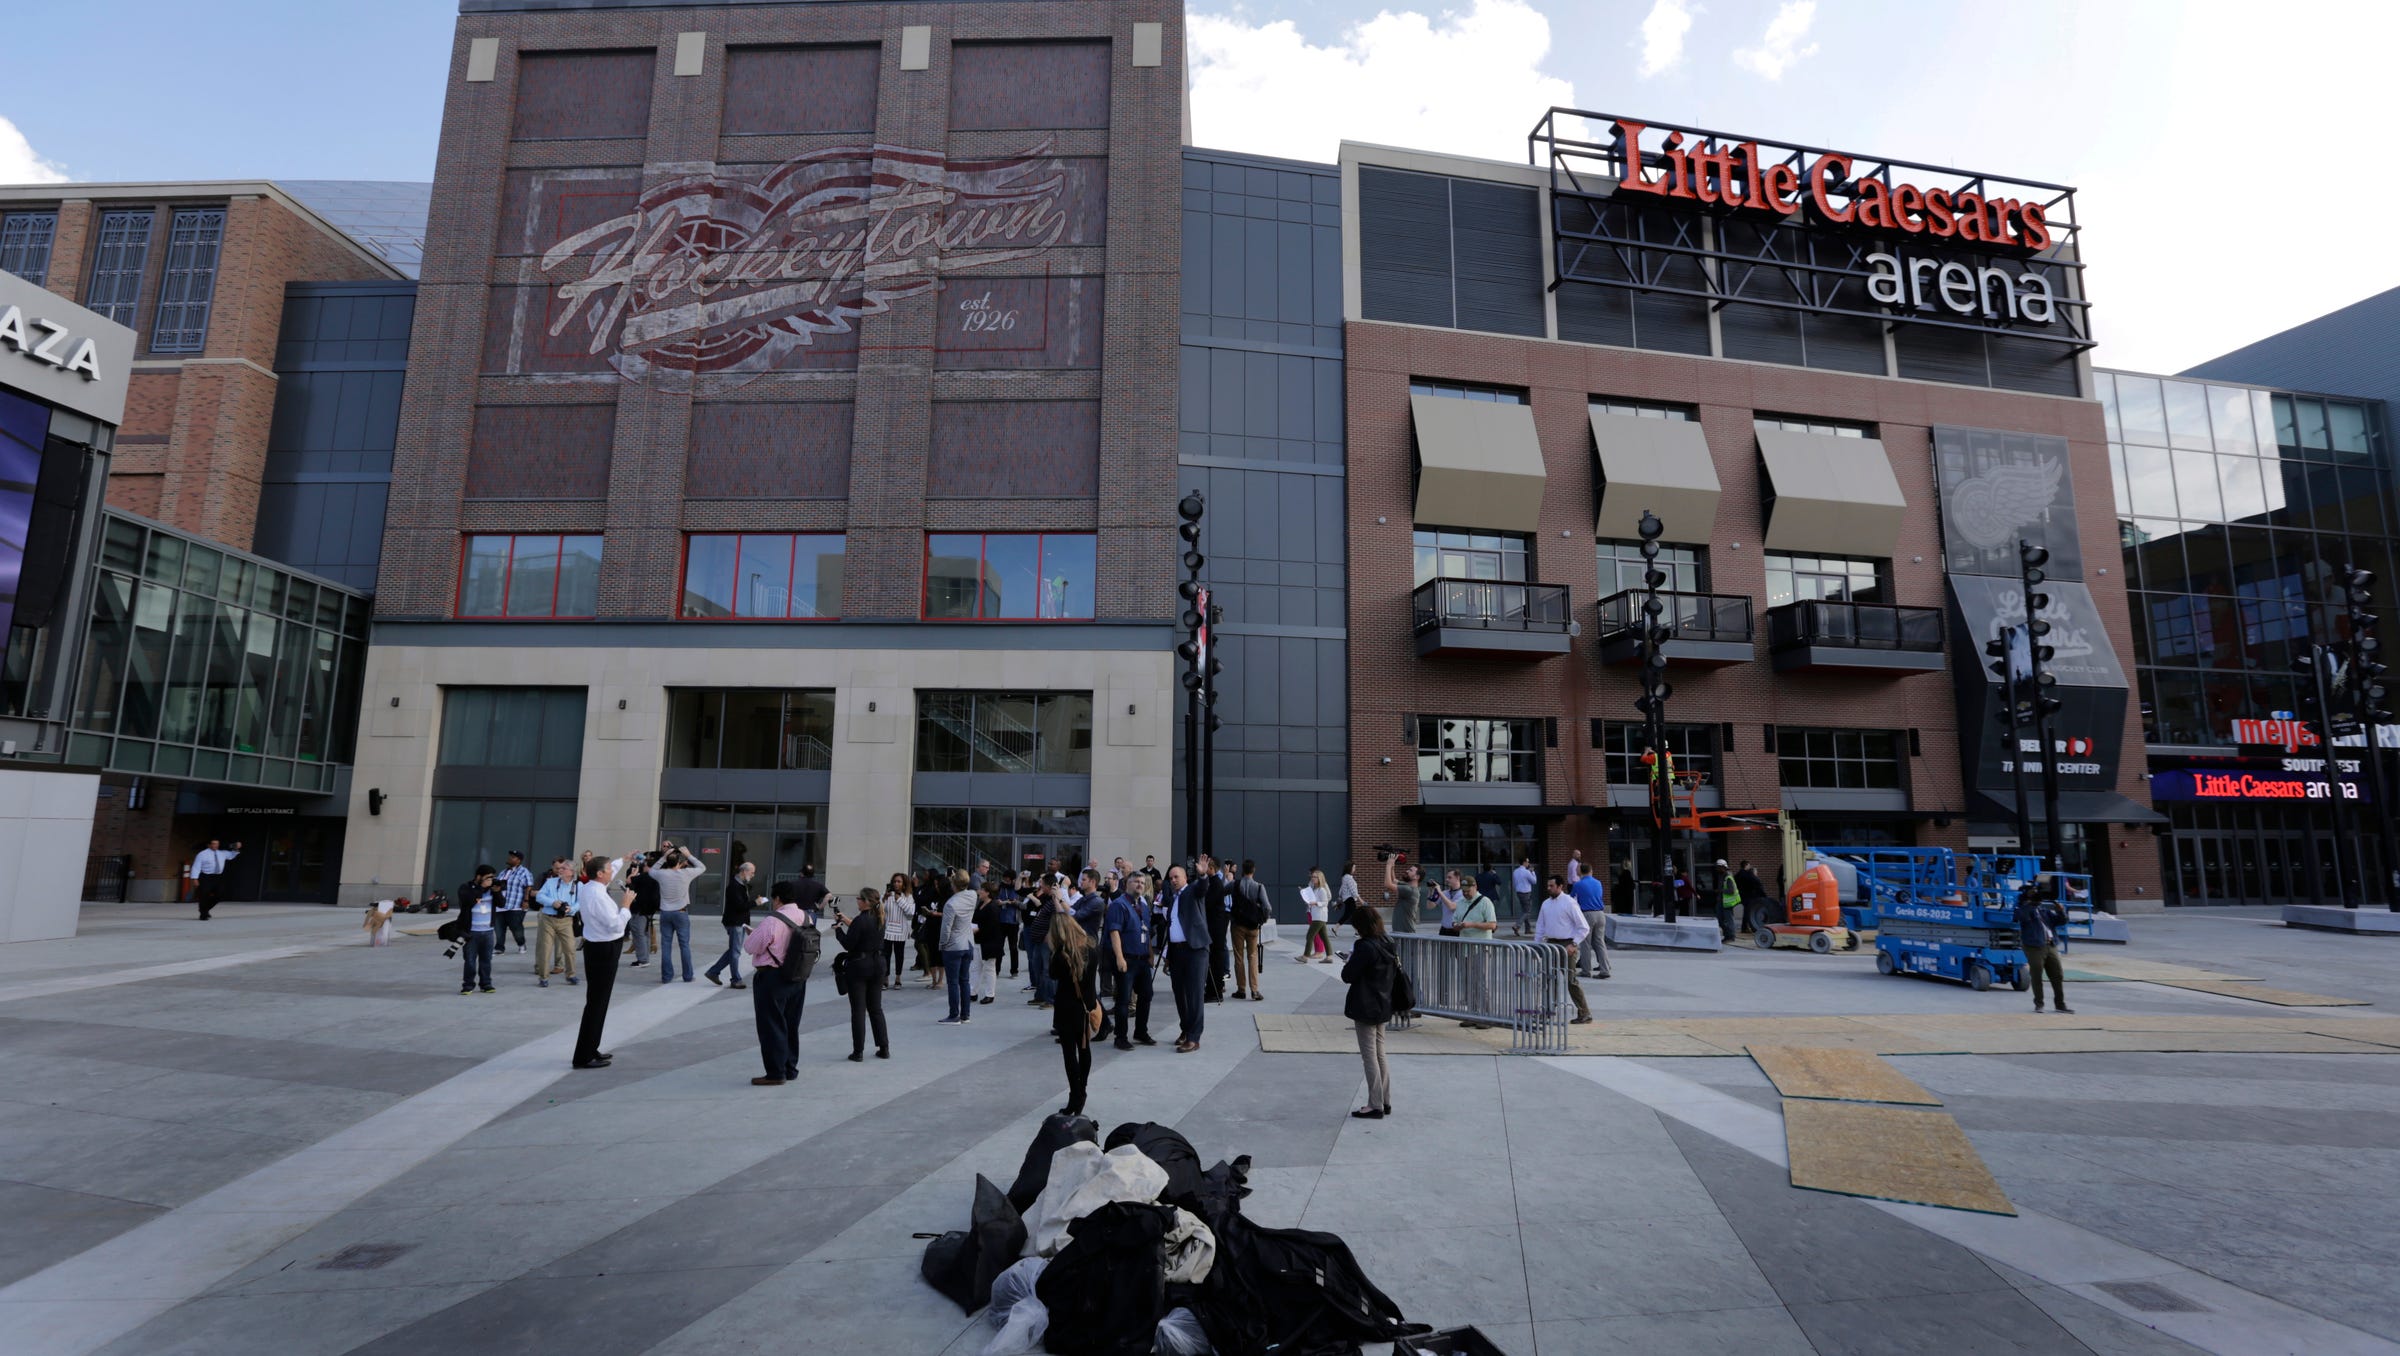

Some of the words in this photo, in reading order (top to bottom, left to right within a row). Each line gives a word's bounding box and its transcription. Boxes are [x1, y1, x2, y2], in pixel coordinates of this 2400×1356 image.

[1616, 119, 1799, 214] Little
[1811, 153, 2051, 252] Caesars
[541, 178, 1066, 354] Hockeytown
[1866, 252, 2057, 323] arena
[960, 291, 991, 310] est.
[962, 310, 1019, 331] 1926
[2056, 763, 2100, 775] CENTER
[2193, 773, 2241, 797] Little
[2241, 774, 2305, 798] Caesars
[1916, 908, 1951, 920] GS-2032
